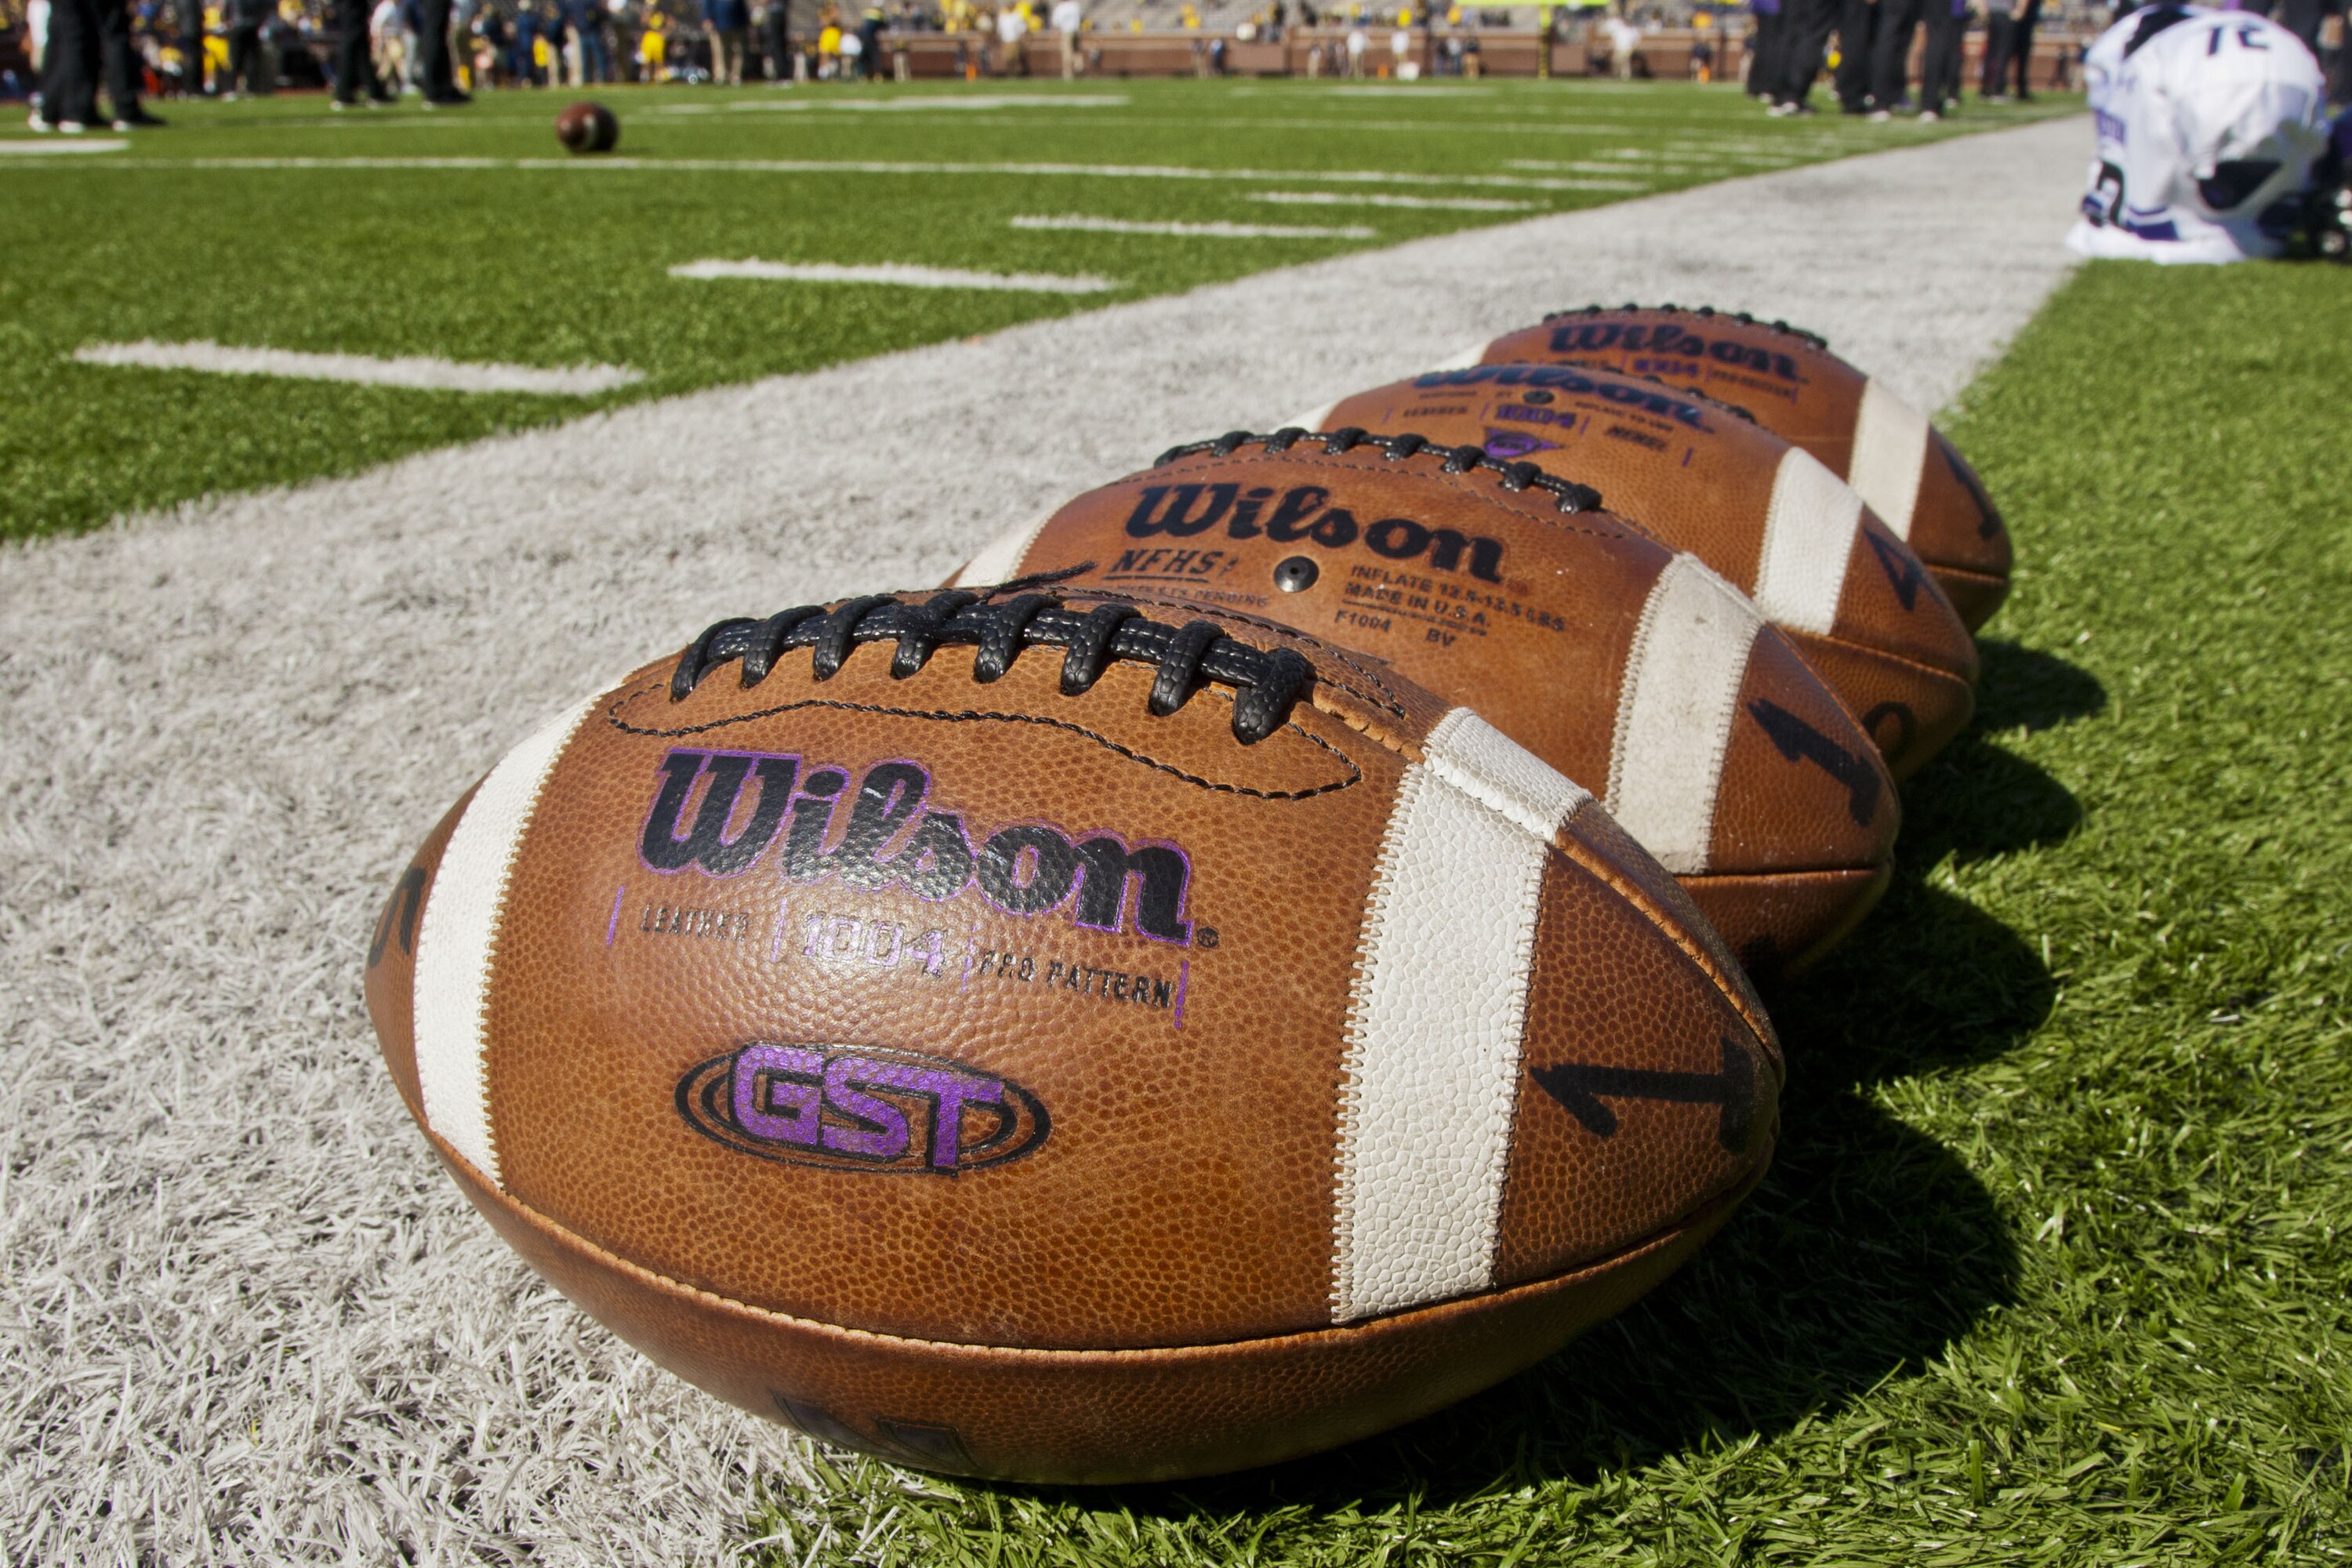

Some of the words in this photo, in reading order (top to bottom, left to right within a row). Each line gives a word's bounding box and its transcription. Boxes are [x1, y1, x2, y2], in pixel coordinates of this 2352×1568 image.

[1550, 323, 1798, 381] Wilson
[1414, 365, 1701, 430] Wilson
[1126, 482, 1504, 585] Wilson
[1194, 589, 1269, 608] PENDING
[1344, 581, 1403, 605] MADE
[1407, 596, 1428, 612] IN
[1350, 564, 1433, 593] INFLATE
[1526, 608, 1566, 633] LBS
[1425, 627, 1457, 647] BV
[637, 748, 1195, 949] Wilson
[640, 904, 750, 942] LEATHER
[804, 909, 950, 979] 1004
[978, 949, 1035, 983] PRO
[1046, 960, 1173, 1011] PATTERN
[729, 1042, 1004, 1176] GST
